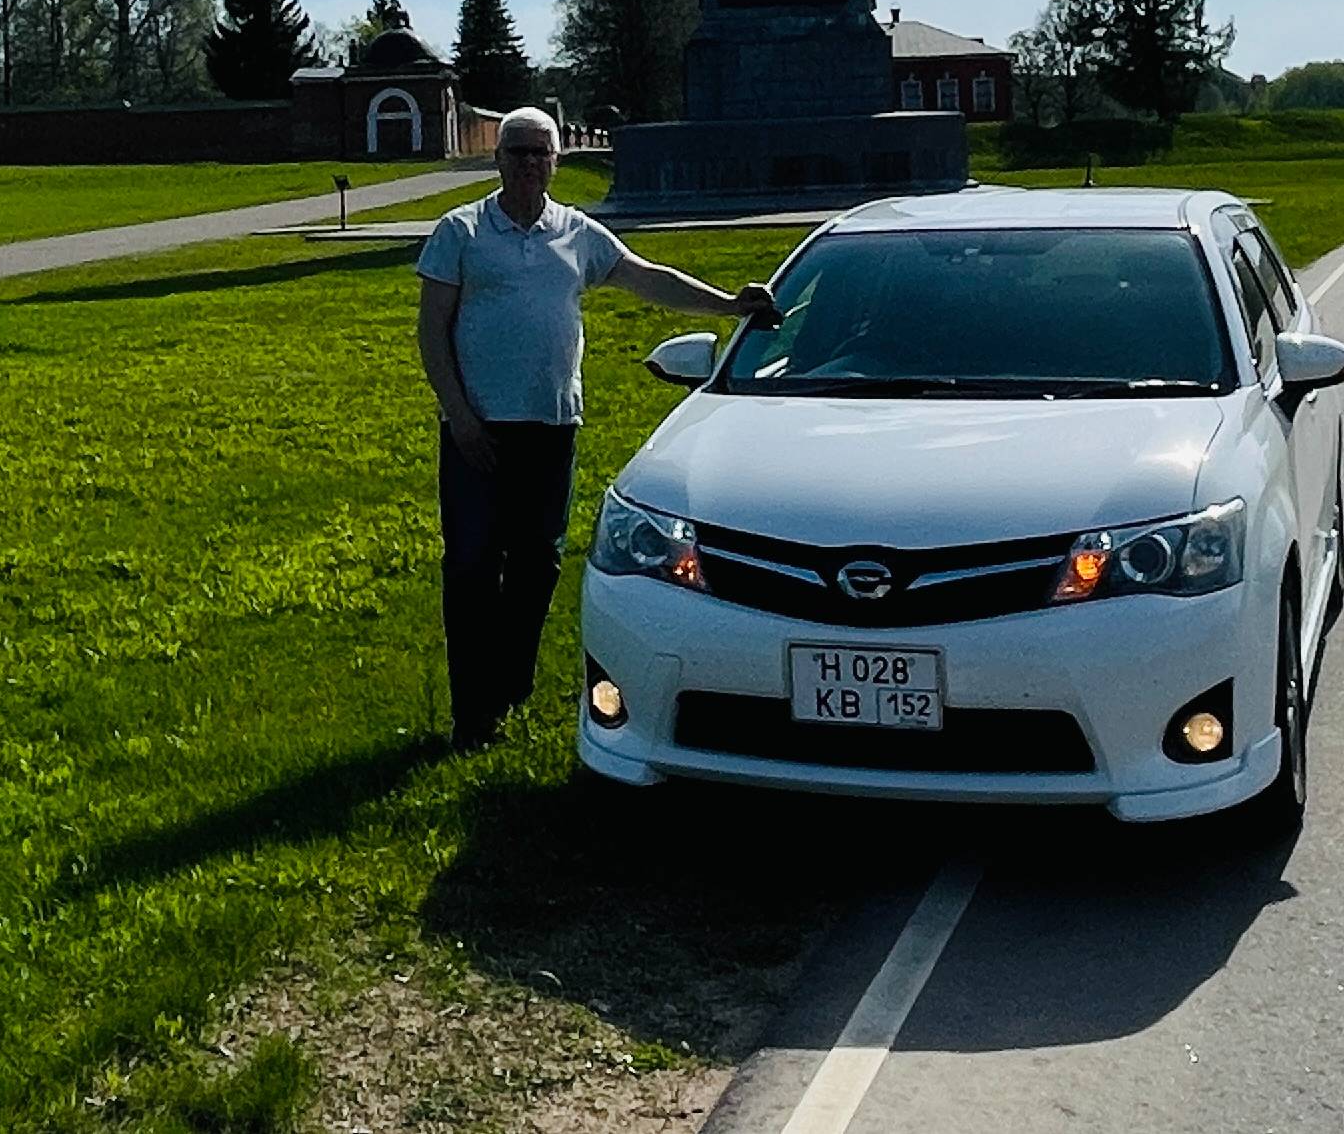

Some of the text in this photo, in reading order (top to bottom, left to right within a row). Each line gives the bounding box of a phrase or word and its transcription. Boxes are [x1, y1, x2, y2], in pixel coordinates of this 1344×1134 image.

[819, 653, 909, 684] Н 028
[816, 688, 931, 718] КВ 152
